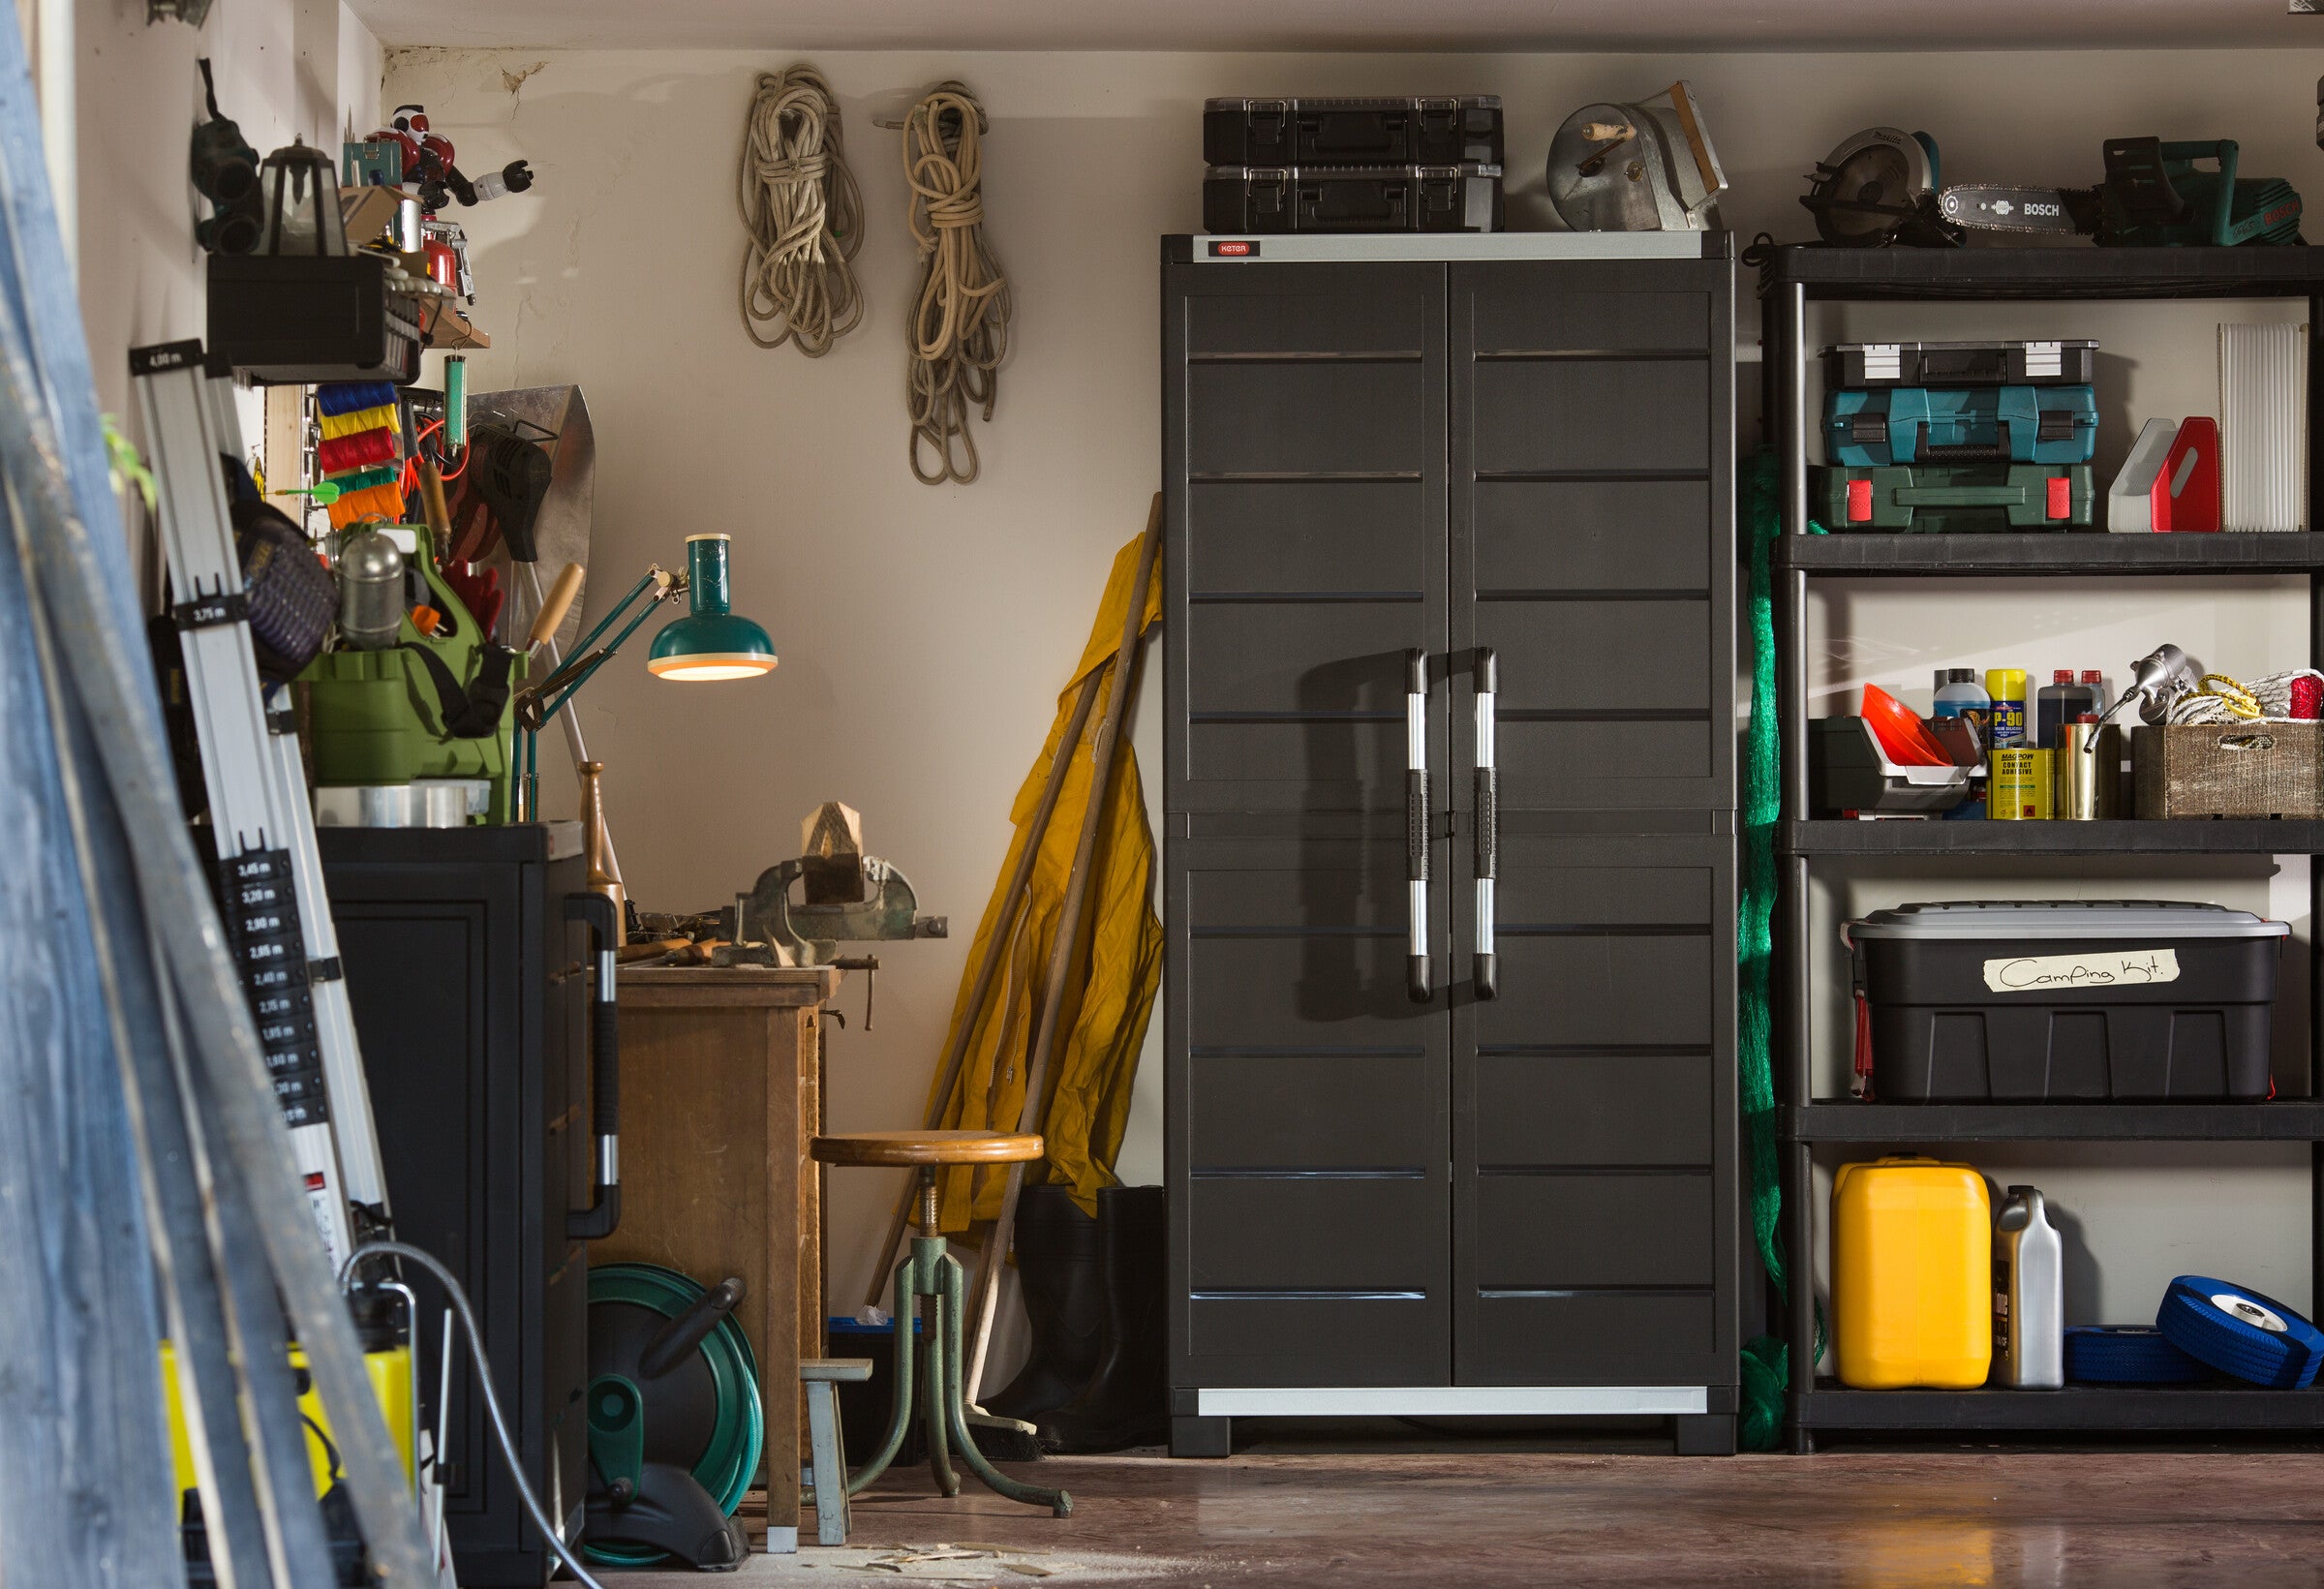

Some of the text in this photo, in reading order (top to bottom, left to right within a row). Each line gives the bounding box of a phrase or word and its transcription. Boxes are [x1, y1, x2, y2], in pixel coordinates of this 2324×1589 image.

[2025, 203, 2059, 216] BOSCH
[2264, 199, 2300, 226] BOSCH
[2000, 959, 2115, 987] Camping
